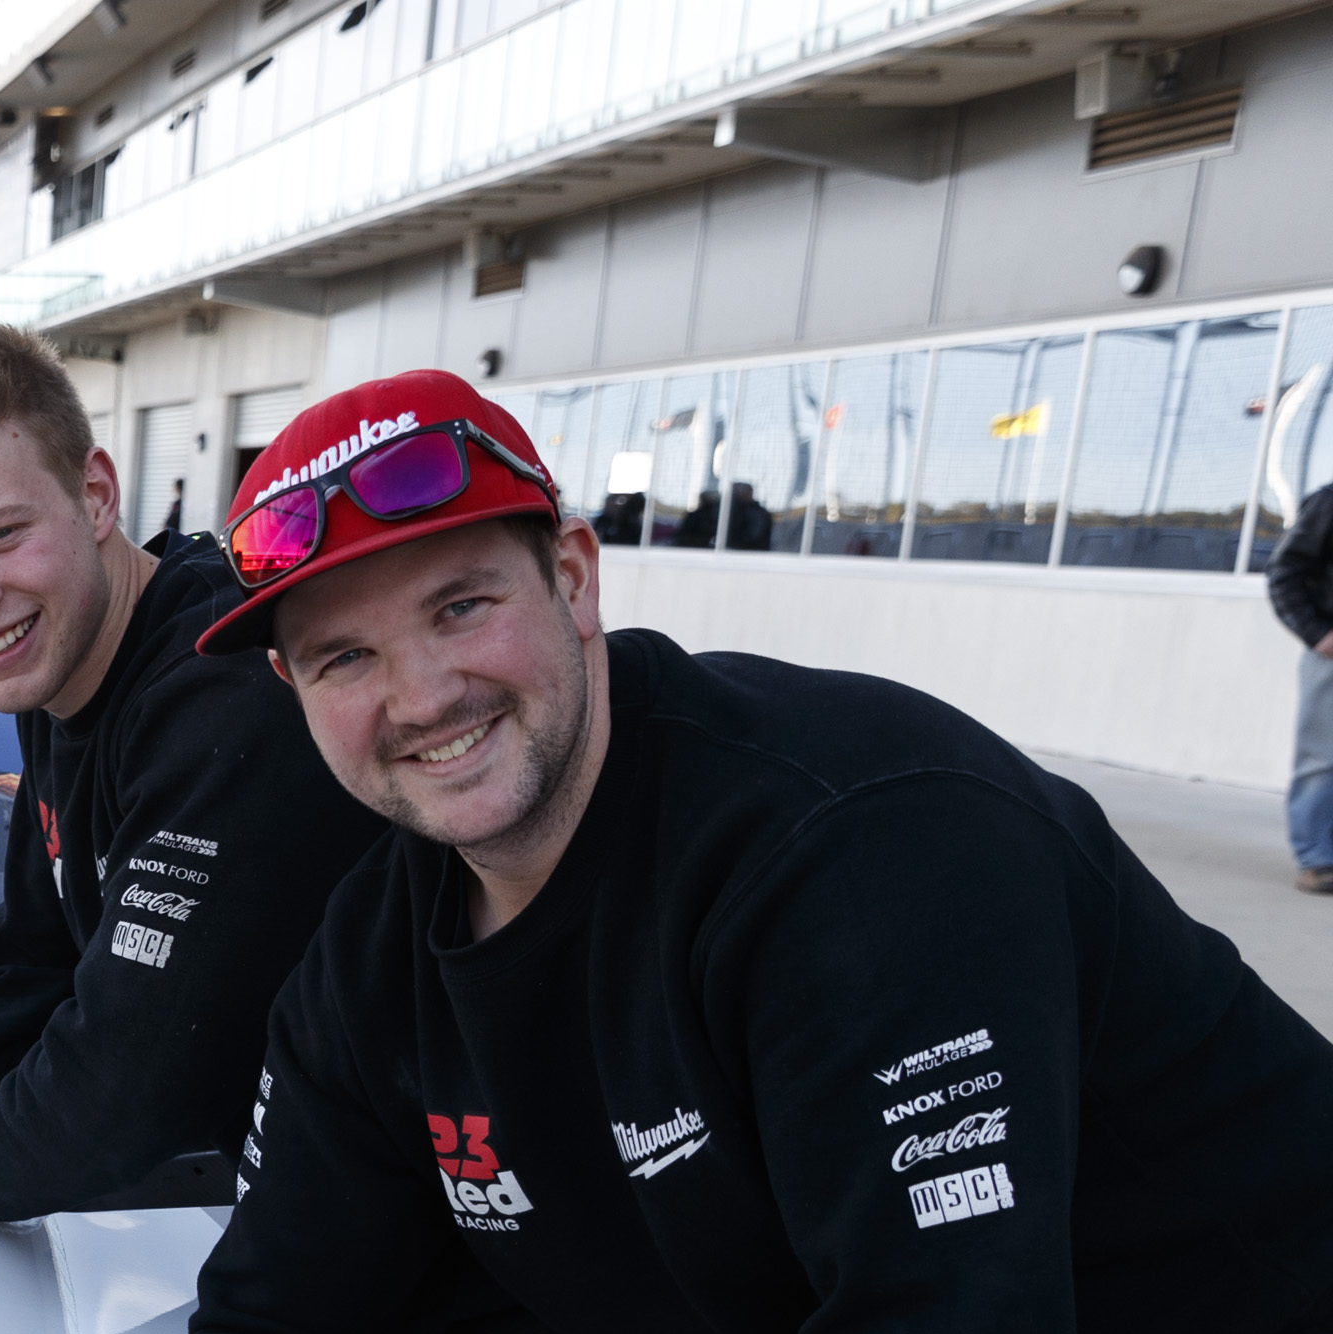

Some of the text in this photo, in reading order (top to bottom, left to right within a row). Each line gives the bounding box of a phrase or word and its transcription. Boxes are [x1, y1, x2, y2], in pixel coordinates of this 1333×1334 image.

[152, 838, 198, 853] HAULAGE
[156, 830, 219, 850] WILTRANS
[129, 858, 167, 875] KNOX
[167, 865, 209, 885] FORD
[903, 1028, 990, 1069] WILTRANS
[906, 1048, 968, 1077] HAULAGE
[882, 1071, 1003, 1125] KNOX FORD
[427, 1113, 500, 1180] 23
[611, 1107, 704, 1164] Milwaukee
[453, 1213, 520, 1231] RACING
